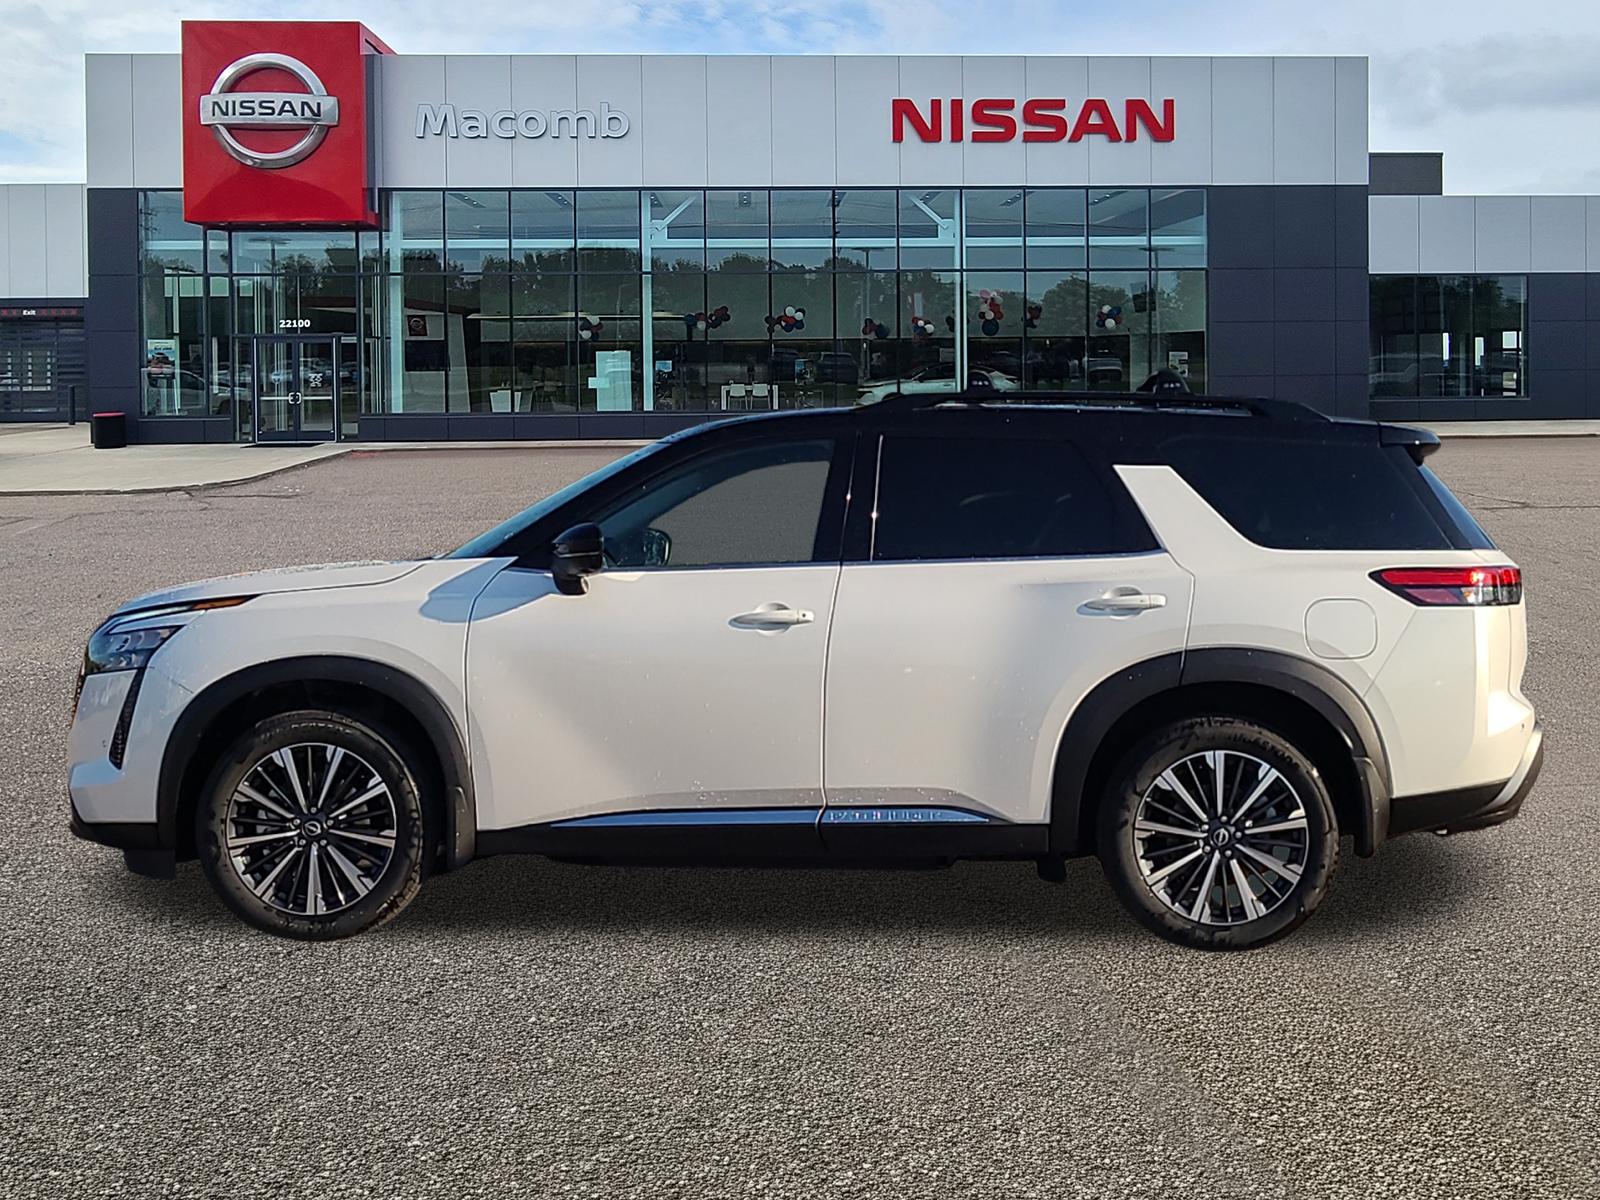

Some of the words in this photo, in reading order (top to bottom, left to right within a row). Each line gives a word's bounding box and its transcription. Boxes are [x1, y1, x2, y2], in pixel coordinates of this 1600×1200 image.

[212, 100, 322, 117] NISSAN
[415, 102, 630, 139] Macomb
[892, 98, 1176, 143] NISSAN
[279, 319, 311, 328] 22100
